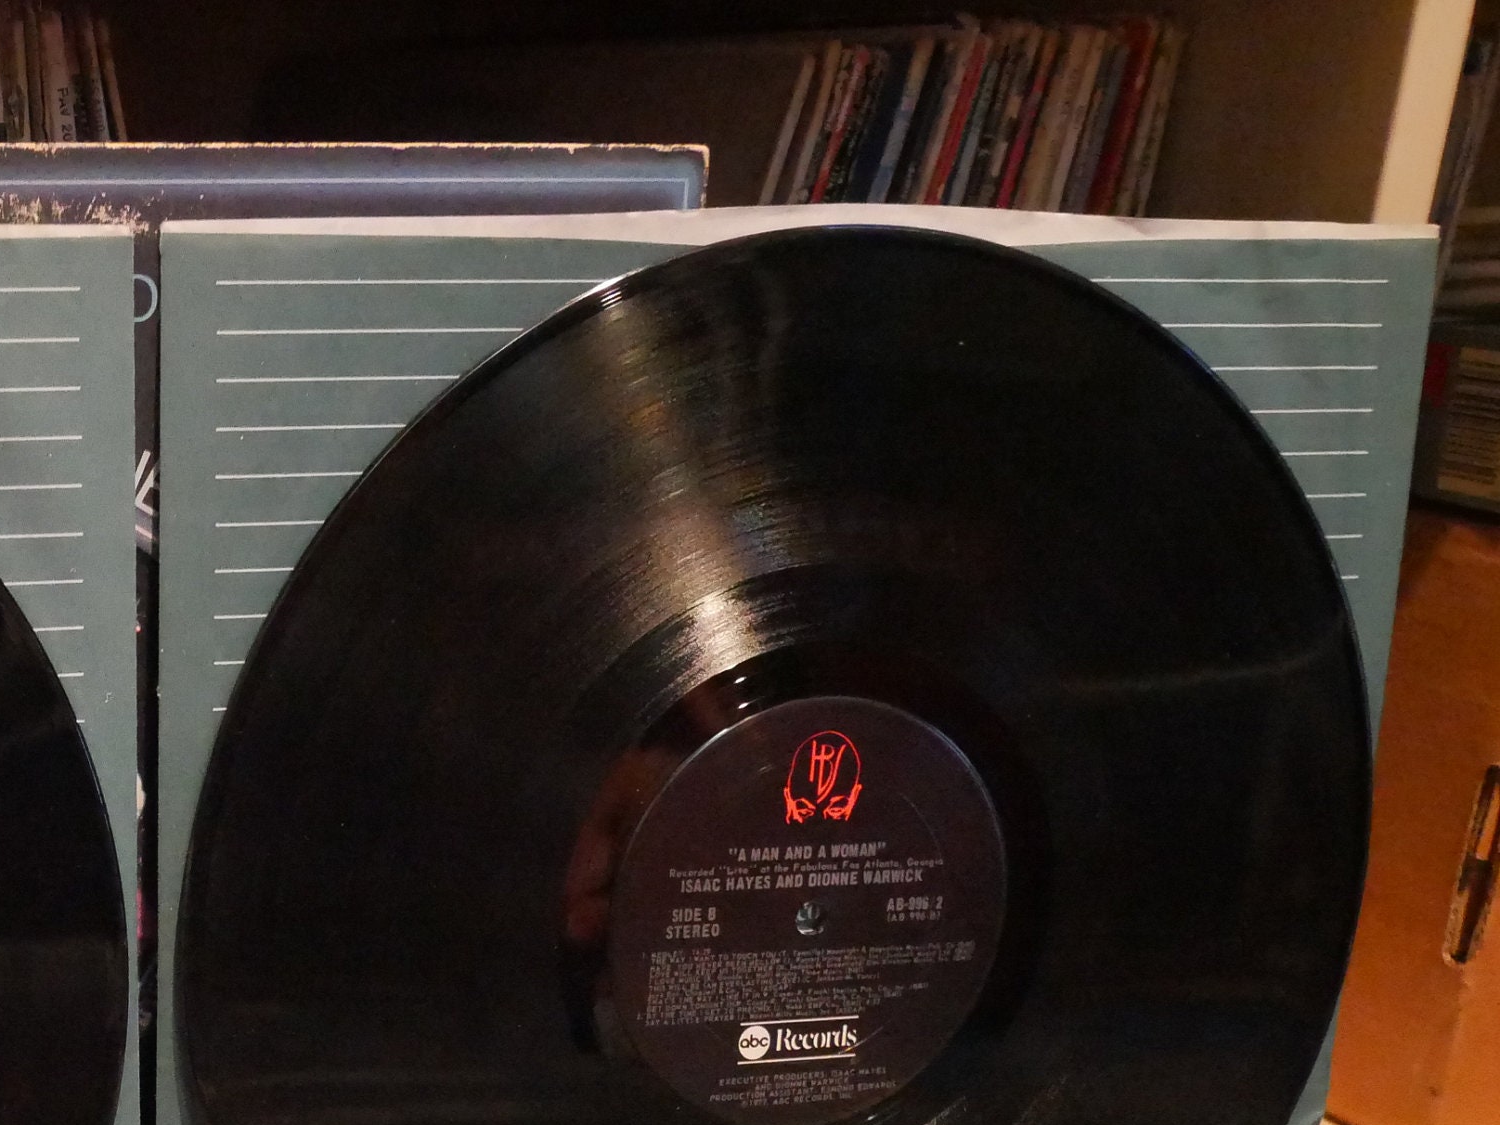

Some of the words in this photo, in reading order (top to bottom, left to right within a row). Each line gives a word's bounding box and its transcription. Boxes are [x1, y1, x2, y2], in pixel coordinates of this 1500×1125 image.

[729, 847, 747, 862] "A
[751, 847, 779, 861] MAN
[785, 846, 813, 860] AND
[817, 845, 827, 858] A
[831, 842, 887, 858] WOMAN"
[669, 867, 715, 878] Recorded
[760, 865, 771, 873] at
[773, 863, 789, 873] the
[792, 861, 838, 872] Fabulous
[907, 857, 944, 868] Georgia
[681, 879, 721, 893] ISAAC
[726, 878, 771, 891] HAYES
[776, 876, 803, 889] AND
[808, 873, 859, 888] DIONNE
[863, 869, 923, 885] WARWICK
[672, 908, 702, 922] SIDE
[708, 906, 717, 921] B
[666, 923, 720, 940] STEREO
[740, 1034, 769, 1048] abc
[776, 1024, 857, 1052] Records
[719, 1075, 770, 1086] EXECUTIVE
[709, 1092, 766, 1103] PRODUCTION
